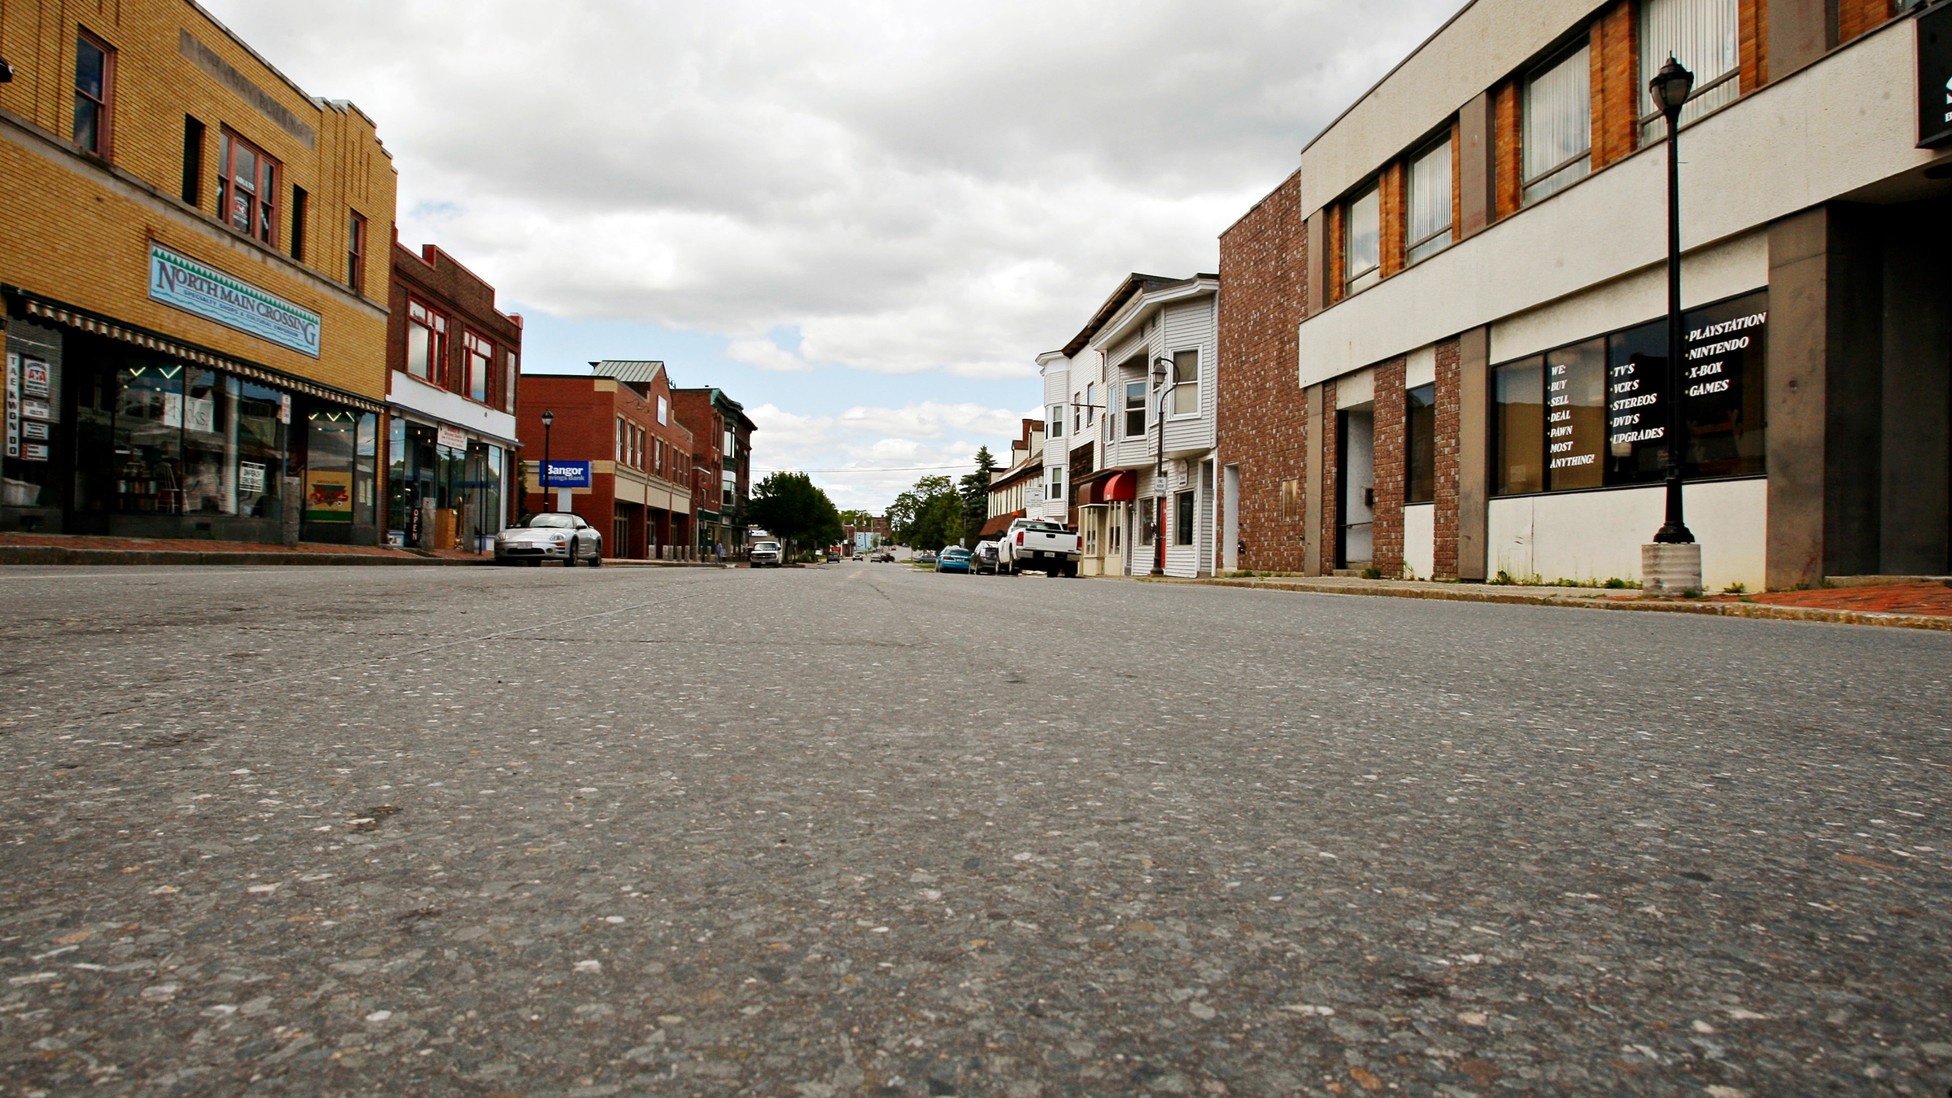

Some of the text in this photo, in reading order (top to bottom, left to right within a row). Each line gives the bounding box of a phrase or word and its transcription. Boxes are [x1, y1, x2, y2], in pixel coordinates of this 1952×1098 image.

[157, 260, 317, 346] NORTH MAIN CROSSING
[184, 289, 217, 306] SPECIALTY
[1689, 312, 1767, 342] PLAYSTATION
[1689, 336, 1749, 360] NINTENDO
[1614, 363, 1635, 377] TV'S
[1689, 361, 1723, 379] X-BOX
[1550, 380, 1567, 391] BUY
[1614, 379, 1640, 394] VCR'S
[1689, 379, 1730, 397] GAMES
[1550, 395, 1569, 407] SELL
[1612, 393, 1657, 411] STEREOS
[1550, 410, 1571, 422] DEAL
[1612, 413, 1640, 428] DVD'S
[1550, 425, 1573, 438] PAWN
[1612, 427, 1665, 444] UPGRADES
[1550, 441, 1573, 453] MOST
[1550, 454, 1595, 469] ANYTHING!
[547, 464, 584, 477] Bangor
